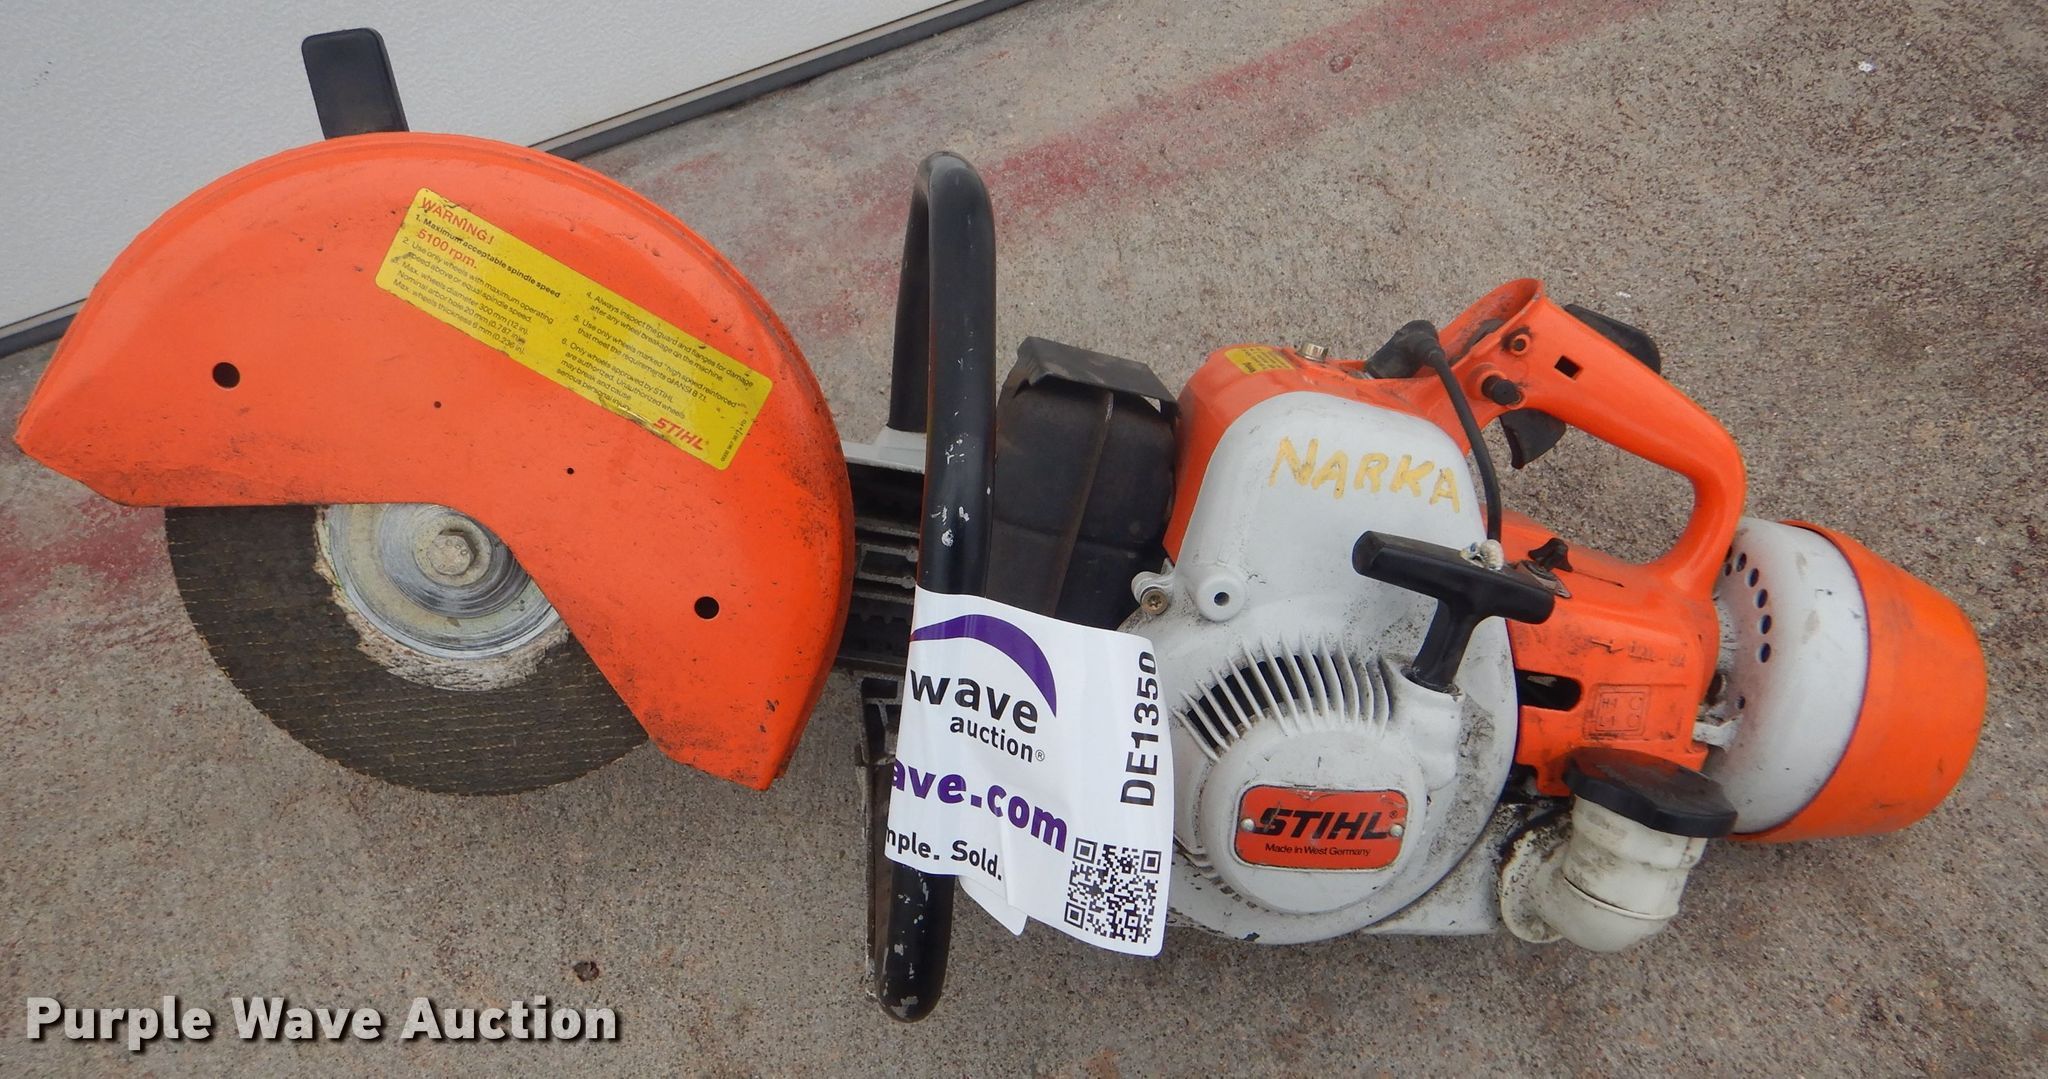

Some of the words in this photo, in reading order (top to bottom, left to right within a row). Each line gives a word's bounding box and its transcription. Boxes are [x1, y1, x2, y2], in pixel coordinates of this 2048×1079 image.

[416, 227, 449, 252] 5100
[447, 247, 479, 270] rpm.
[422, 218, 463, 244] Maximum
[461, 239, 507, 269] acceptable
[506, 264, 536, 285] spindle
[535, 280, 560, 298] speed
[397, 270, 428, 290] Nominal
[427, 286, 447, 301] arbor
[447, 297, 464, 310] hole
[411, 242, 426, 254] Use
[426, 250, 442, 263] only
[442, 259, 468, 277] wheels
[468, 273, 484, 285] with
[484, 282, 520, 305] maximum
[518, 301, 554, 325] operating
[412, 289, 438, 307] wheels
[437, 302, 472, 325] thickness
[420, 272, 446, 289] wheels
[446, 285, 478, 307] diameter
[478, 303, 493, 315] 300
[506, 318, 519, 330] (12
[430, 263, 453, 279] above
[460, 280, 482, 296] equal
[481, 291, 508, 310] spindle
[577, 327, 592, 339] that
[591, 335, 610, 349] meet
[609, 345, 622, 356] the
[620, 351, 666, 381] requirements
[581, 319, 597, 331] Use
[595, 326, 612, 340] only
[611, 335, 637, 353] wheels
[636, 348, 663, 367] marked
[680, 373, 703, 390] speed
[589, 304, 606, 317] after
[605, 313, 619, 325] any
[619, 320, 641, 335] wheel
[639, 332, 673, 354] breakage
[681, 354, 694, 365] the
[593, 295, 620, 313] Always
[618, 309, 646, 328] inspect
[645, 323, 658, 334] the
[656, 329, 678, 346] guard
[677, 341, 692, 352] and
[690, 349, 716, 367] flanges
[715, 362, 726, 371] for
[724, 368, 754, 388] damage
[559, 359, 576, 372] may
[576, 367, 596, 381] break
[596, 378, 610, 389] and
[609, 386, 631, 400] cause
[564, 351, 577, 361] are
[615, 378, 661, 406] Unauthorized
[661, 402, 685, 419] wheels
[568, 341, 586, 356] Only
[586, 351, 611, 368] wheels
[610, 364, 644, 387] approved
[652, 387, 674, 402] STIHL
[652, 414, 707, 451] STIHL
[1268, 436, 1460, 513] NARKA
[910, 668, 1039, 734] wave
[1120, 651, 1158, 806] DE1350
[950, 839, 1003, 881] Sold.
[1265, 842, 1293, 853] Made
[1295, 844, 1303, 854] in
[1304, 845, 1327, 855] West
[1329, 846, 1371, 857] Germany
